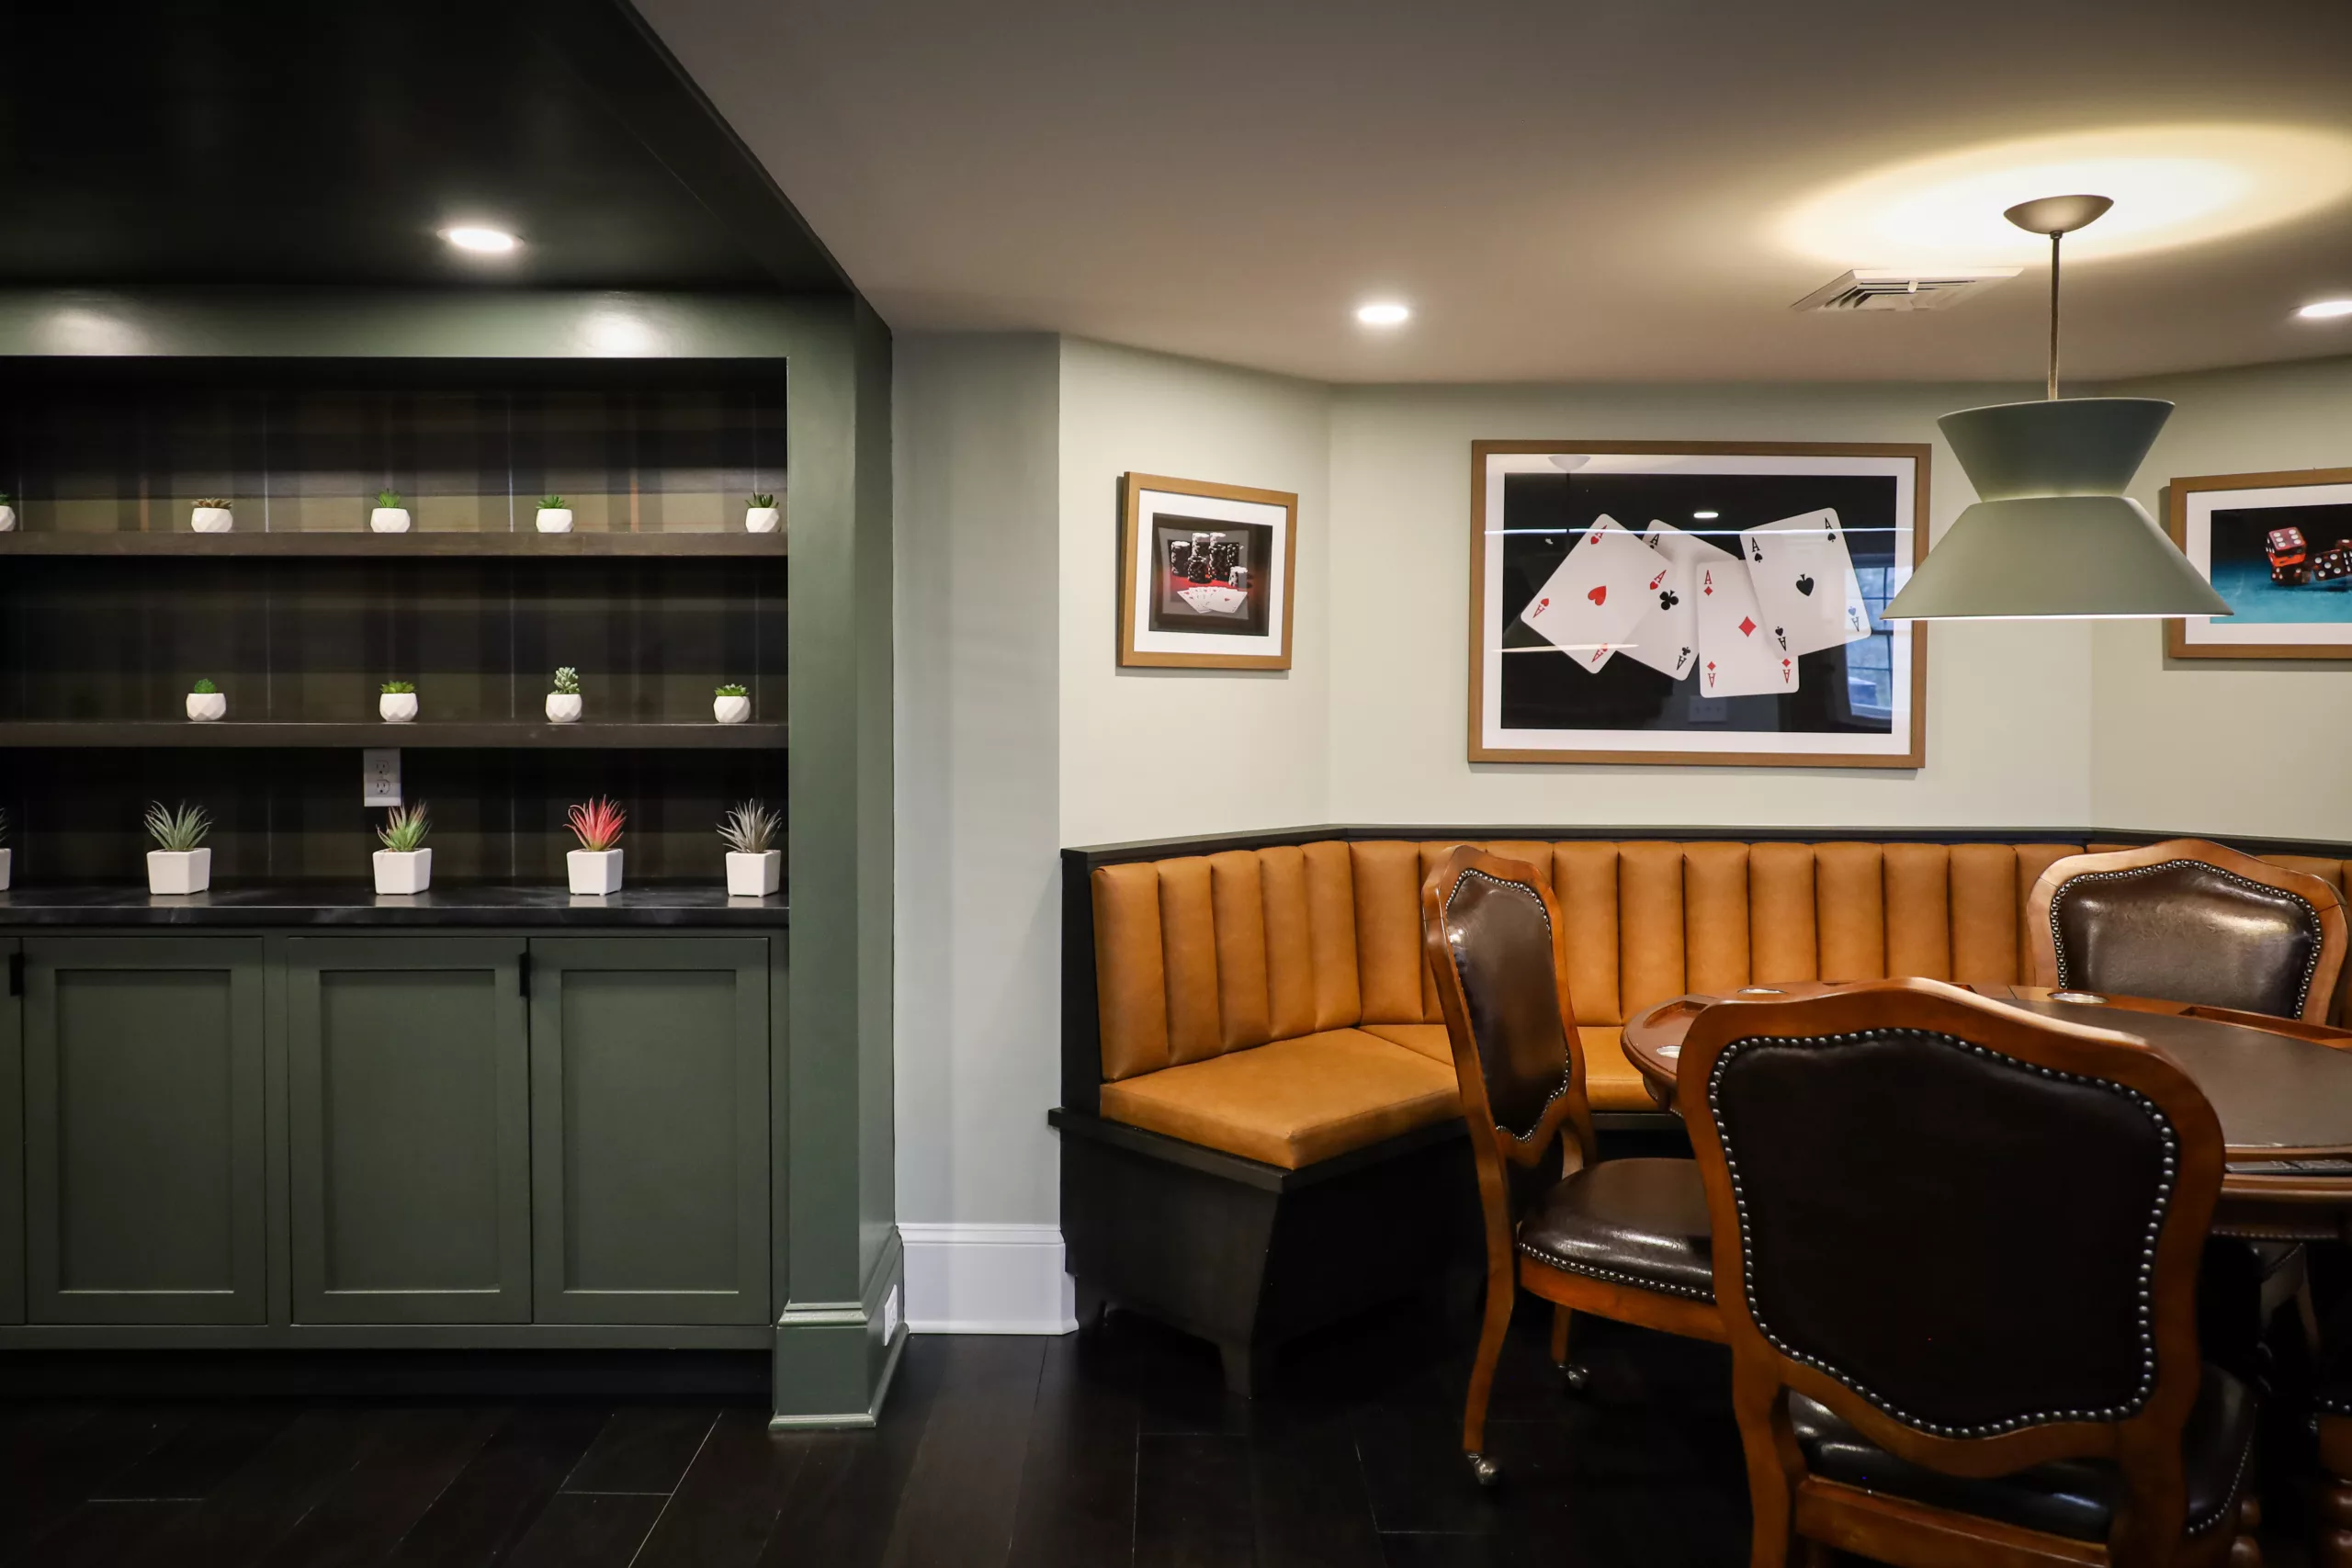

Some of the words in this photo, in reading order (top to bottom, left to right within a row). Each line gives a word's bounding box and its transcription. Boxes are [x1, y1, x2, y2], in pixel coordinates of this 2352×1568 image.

[1595, 525, 1608, 539] A
[1650, 534, 1660, 547] A
[1751, 536, 1760, 552] A
[1654, 570, 1667, 583] A
[1704, 570, 1713, 585] A
[1532, 604, 1545, 618] A
[1851, 616, 1860, 632] A
[1777, 636, 1787, 652] A
[1591, 649, 1604, 663] A
[1676, 655, 1687, 671] A
[1707, 672, 1716, 688] A
[1782, 669, 1791, 684] A
